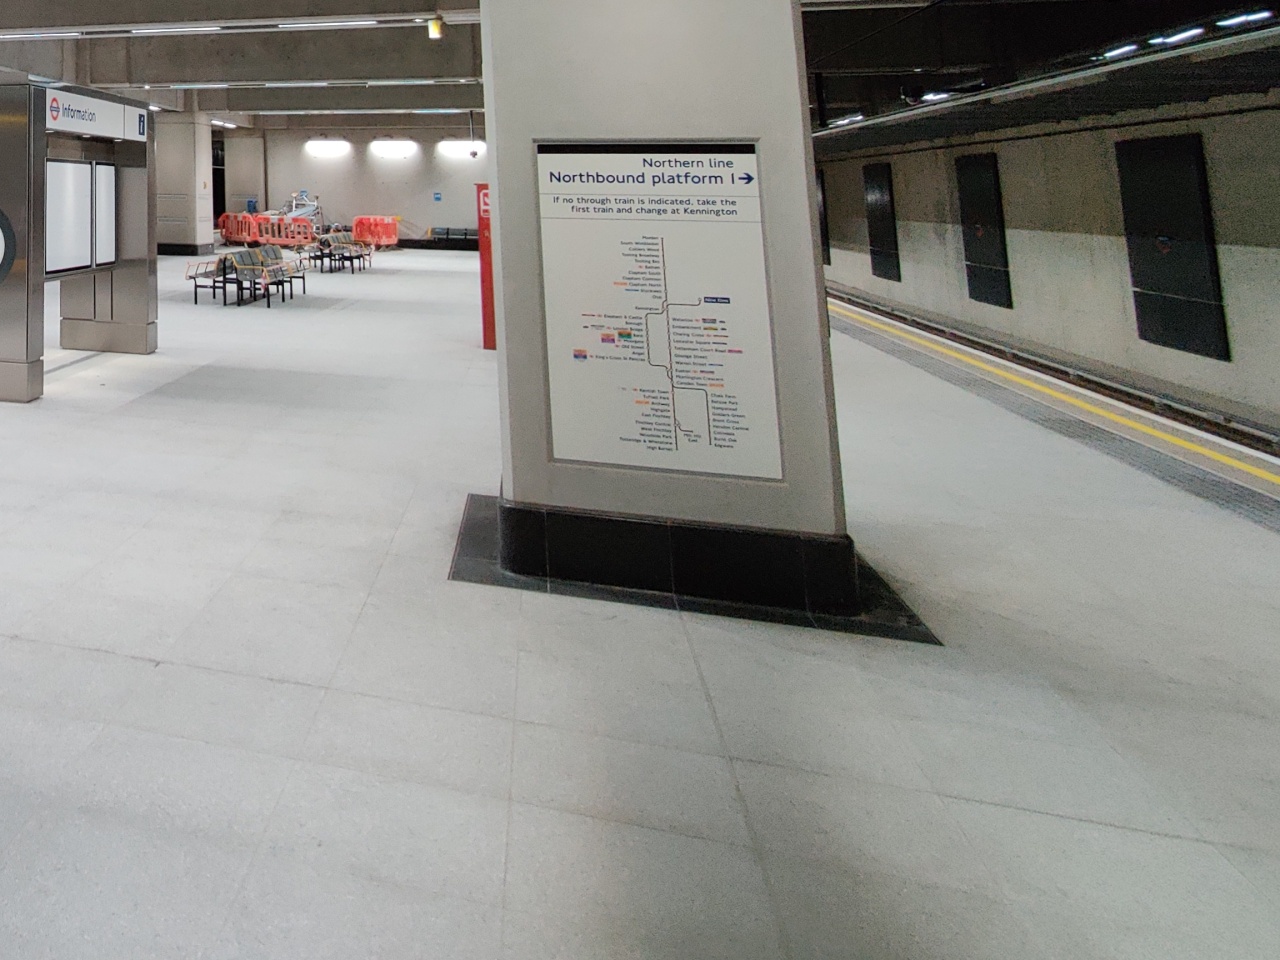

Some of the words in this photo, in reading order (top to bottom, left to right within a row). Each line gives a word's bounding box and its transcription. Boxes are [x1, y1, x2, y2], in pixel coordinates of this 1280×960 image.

[61, 102, 97, 123] Information
[642, 158, 704, 168] Northern
[709, 158, 734, 168] line
[549, 171, 646, 184] Northbound
[652, 172, 724, 187] platform
[553, 196, 560, 204] If
[577, 197, 612, 206] through
[614, 197, 635, 205] train
[638, 197, 646, 205] is
[697, 198, 718, 206] take
[720, 198, 737, 206] the
[571, 205, 591, 213] first
[635, 207, 668, 216] change
[683, 207, 738, 217] Kennington
